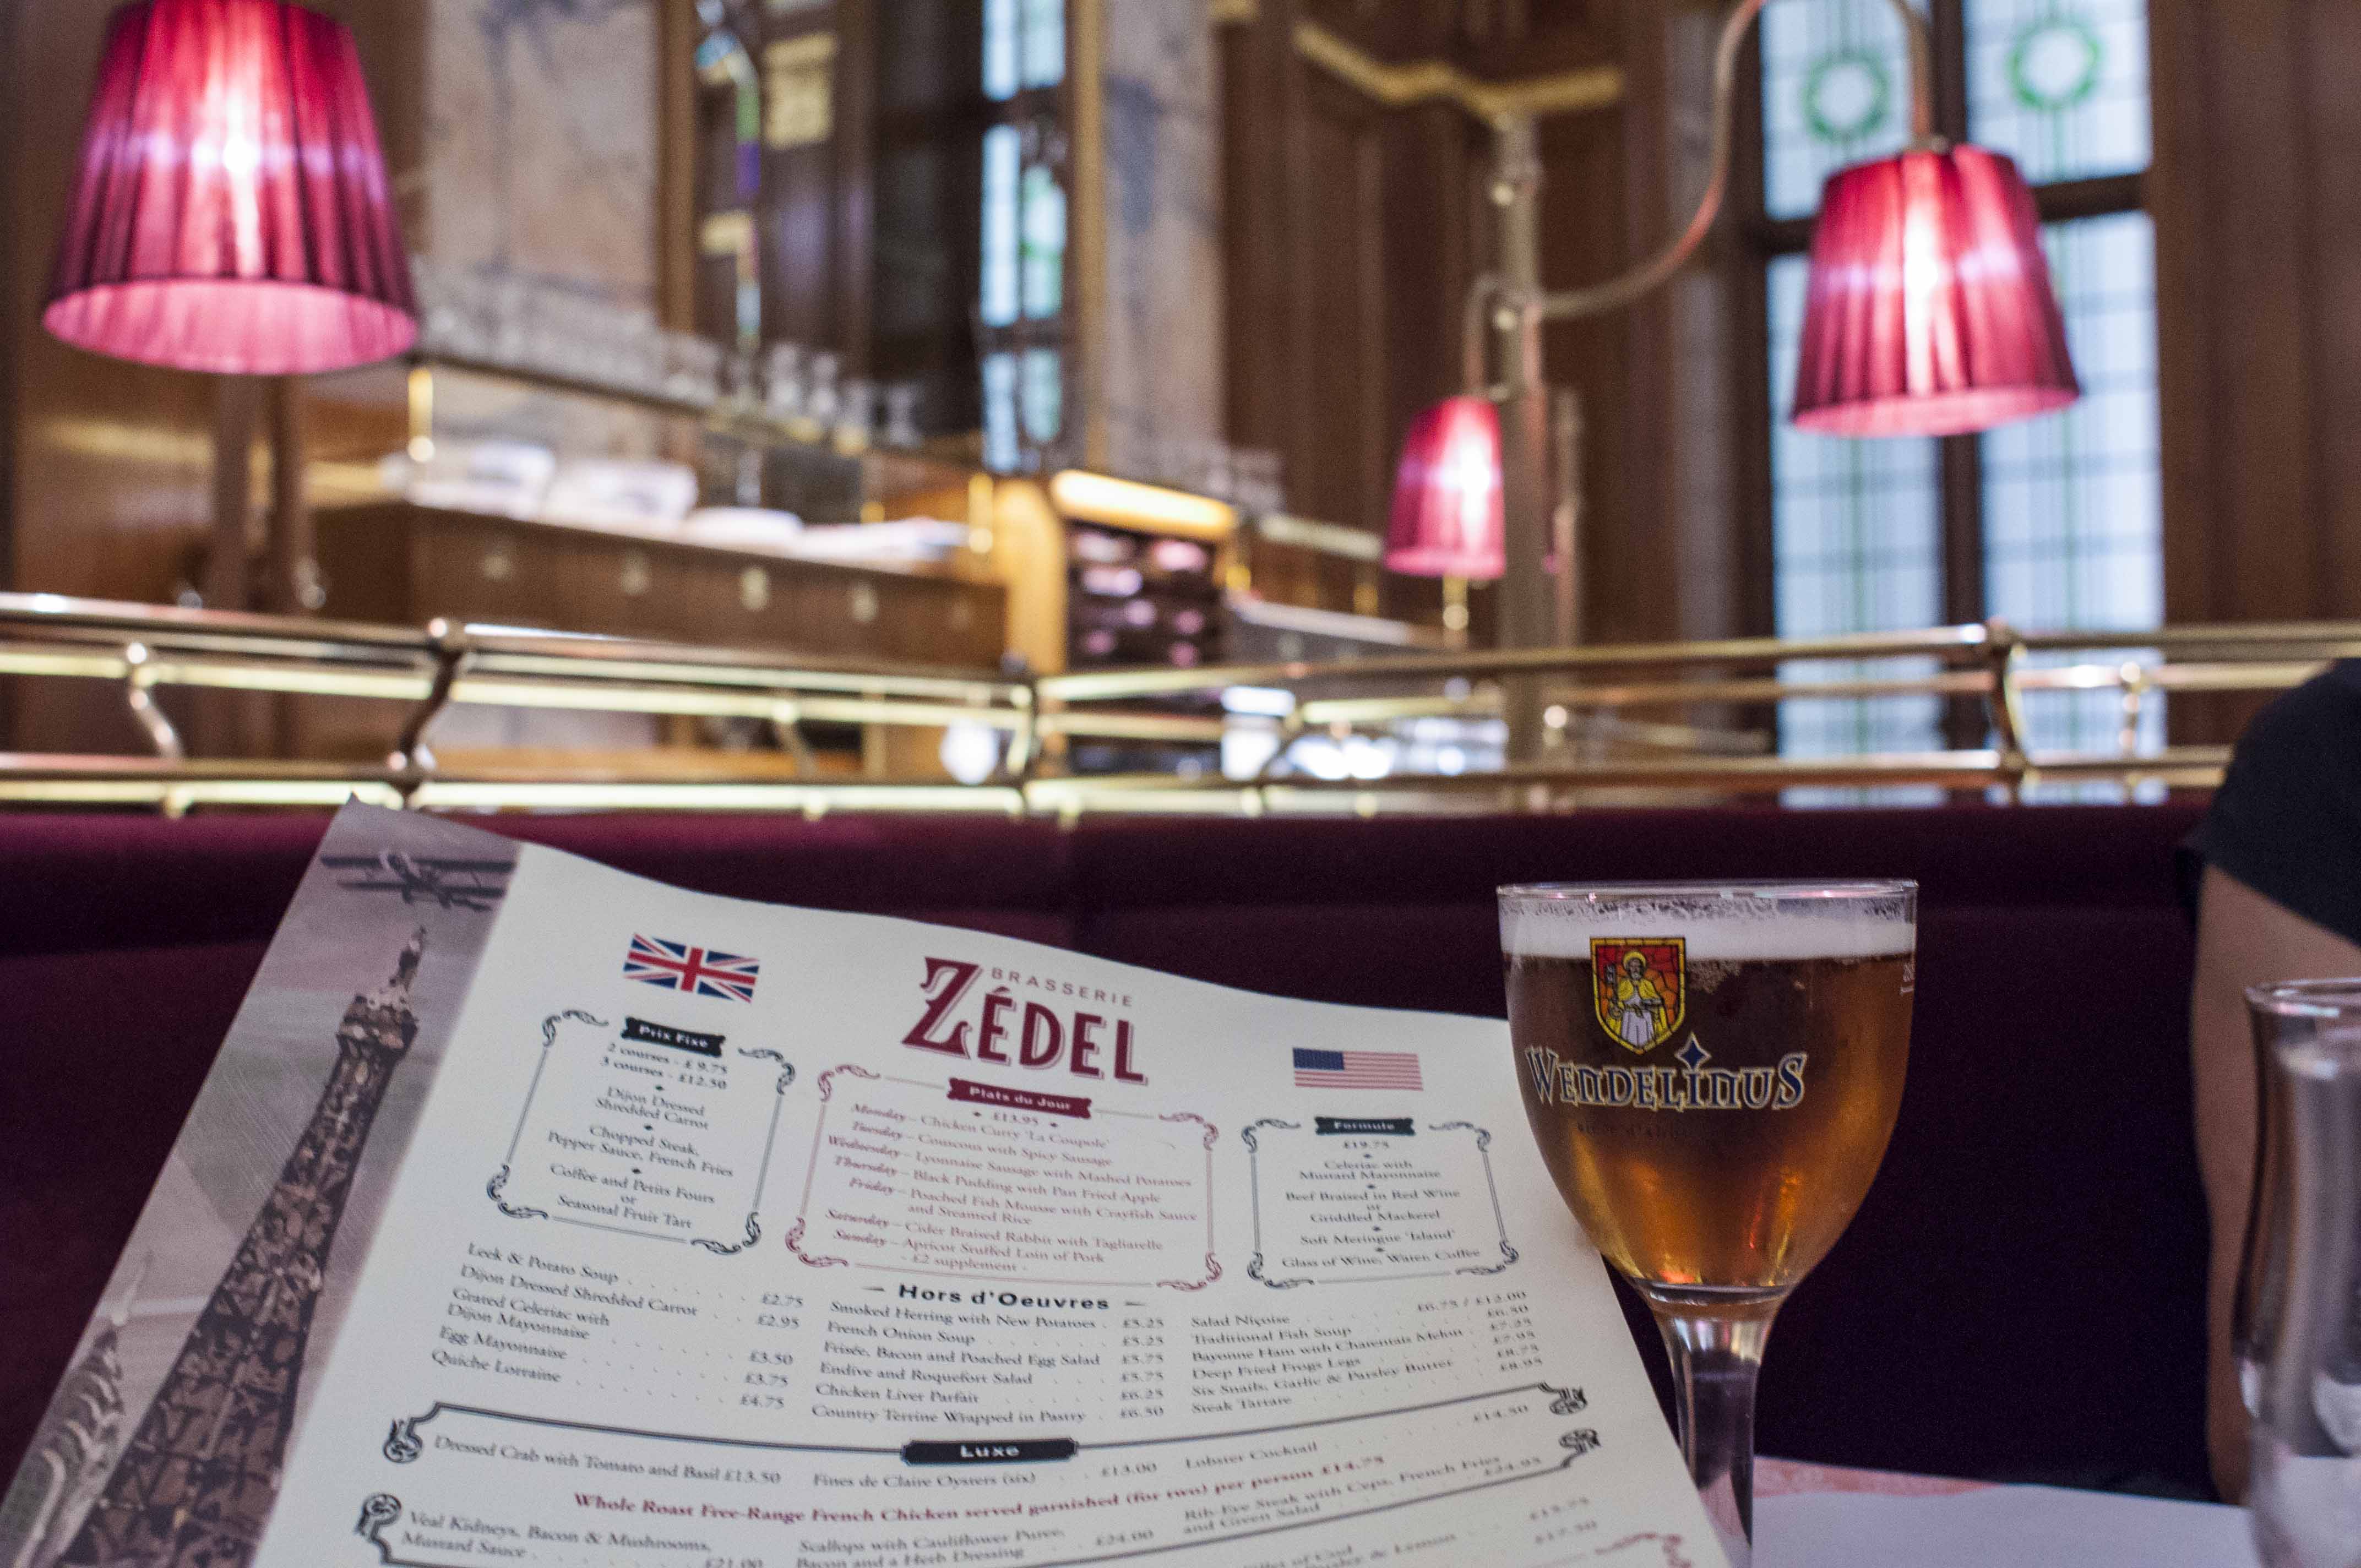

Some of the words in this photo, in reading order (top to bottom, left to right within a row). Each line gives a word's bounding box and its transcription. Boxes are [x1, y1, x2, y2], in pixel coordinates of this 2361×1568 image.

[992, 967, 1133, 1007] BRASSERIE
[901, 957, 1148, 1085] ZÉDEL
[639, 1025, 670, 1041] Prix
[676, 1032, 709, 1049] Fixe
[1525, 1045, 1809, 1112] WENDELINUS
[970, 1087, 1009, 1101] Plats
[1014, 1093, 1033, 1104] du
[1038, 1098, 1072, 1112] Jour
[589, 1125, 655, 1146] Chopped
[1334, 1121, 1395, 1131] Formule
[547, 1130, 596, 1151] Pepper
[649, 1151, 697, 1170] French
[701, 1161, 734, 1177] Fries
[550, 1163, 599, 1183] Coffee
[600, 1177, 629, 1189] and
[632, 1179, 672, 1196] Petits
[675, 1186, 715, 1204] Fours
[557, 1195, 620, 1216] Seasonal
[623, 1206, 660, 1223] Fruit
[663, 1213, 692, 1228] Tart
[467, 1243, 503, 1261] Leek
[507, 1252, 524, 1265] &
[528, 1255, 576, 1275] Potato
[580, 1266, 619, 1284] Soup
[460, 1265, 505, 1284] Dijon
[509, 1275, 570, 1297] Dressed
[572, 1287, 645, 1308] Shredded
[647, 1299, 698, 1316] Carrot
[898, 1284, 962, 1303] Hors
[970, 1291, 1109, 1309] d'Oeuvres
[447, 1303, 493, 1322] Dijon
[497, 1312, 590, 1339] Mayonnaise
[451, 1288, 507, 1308] Grated
[509, 1299, 572, 1320] Celeriac
[575, 1312, 610, 1326] with
[757, 1314, 800, 1329] £2.95
[830, 1301, 890, 1317] Smoked
[895, 1306, 954, 1325] Herring
[958, 1313, 991, 1325] with
[996, 1314, 1031, 1326] New
[1035, 1316, 1096, 1328] Potatoes
[439, 1326, 470, 1345] Egg
[474, 1332, 568, 1359] Mayonnaise
[827, 1321, 878, 1336] French
[882, 1327, 933, 1341] Onion
[936, 1331, 976, 1346] Soup
[431, 1350, 491, 1370] Quiche
[494, 1359, 562, 1382] Lorraine
[876, 1346, 923, 1360] Bacon
[926, 1350, 956, 1362] and
[960, 1351, 1022, 1365] Poached
[1060, 1354, 1101, 1365] Salad
[819, 1362, 873, 1377] Endive
[877, 1369, 906, 1380] and
[911, 1370, 987, 1385] Roquefort
[992, 1372, 1033, 1384] Salad
[815, 1383, 881, 1398] Chicken
[885, 1387, 925, 1401] Liver
[929, 1390, 978, 1403] Parfait
[811, 1405, 880, 1420] Country
[884, 1408, 939, 1422] Terrine
[943, 1411, 1014, 1425] Wrapped
[1018, 1413, 1035, 1423] in
[1040, 1411, 1086, 1423] Pastry
[434, 1435, 497, 1456] Dressed
[499, 1445, 541, 1462] Crab
[543, 1453, 580, 1467] with
[584, 1455, 645, 1473] Tomato
[648, 1464, 679, 1477] and
[682, 1465, 721, 1480] Basil
[960, 1444, 1020, 1458] Luxe
[813, 1473, 855, 1487] Fines
[858, 1474, 879, 1488] de
[883, 1474, 933, 1487] Claire
[936, 1475, 998, 1486] Oysters
[574, 1493, 636, 1511] Whole
[642, 1500, 694, 1516] Roast
[700, 1504, 805, 1523] Free-Range
[811, 1509, 874, 1522] French
[880, 1508, 959, 1521] Chicken
[965, 1502, 1023, 1517] served
[1028, 1494, 1119, 1516] garnished
[1214, 1481, 1243, 1495] per
[1250, 1471, 1314, 1489] person
